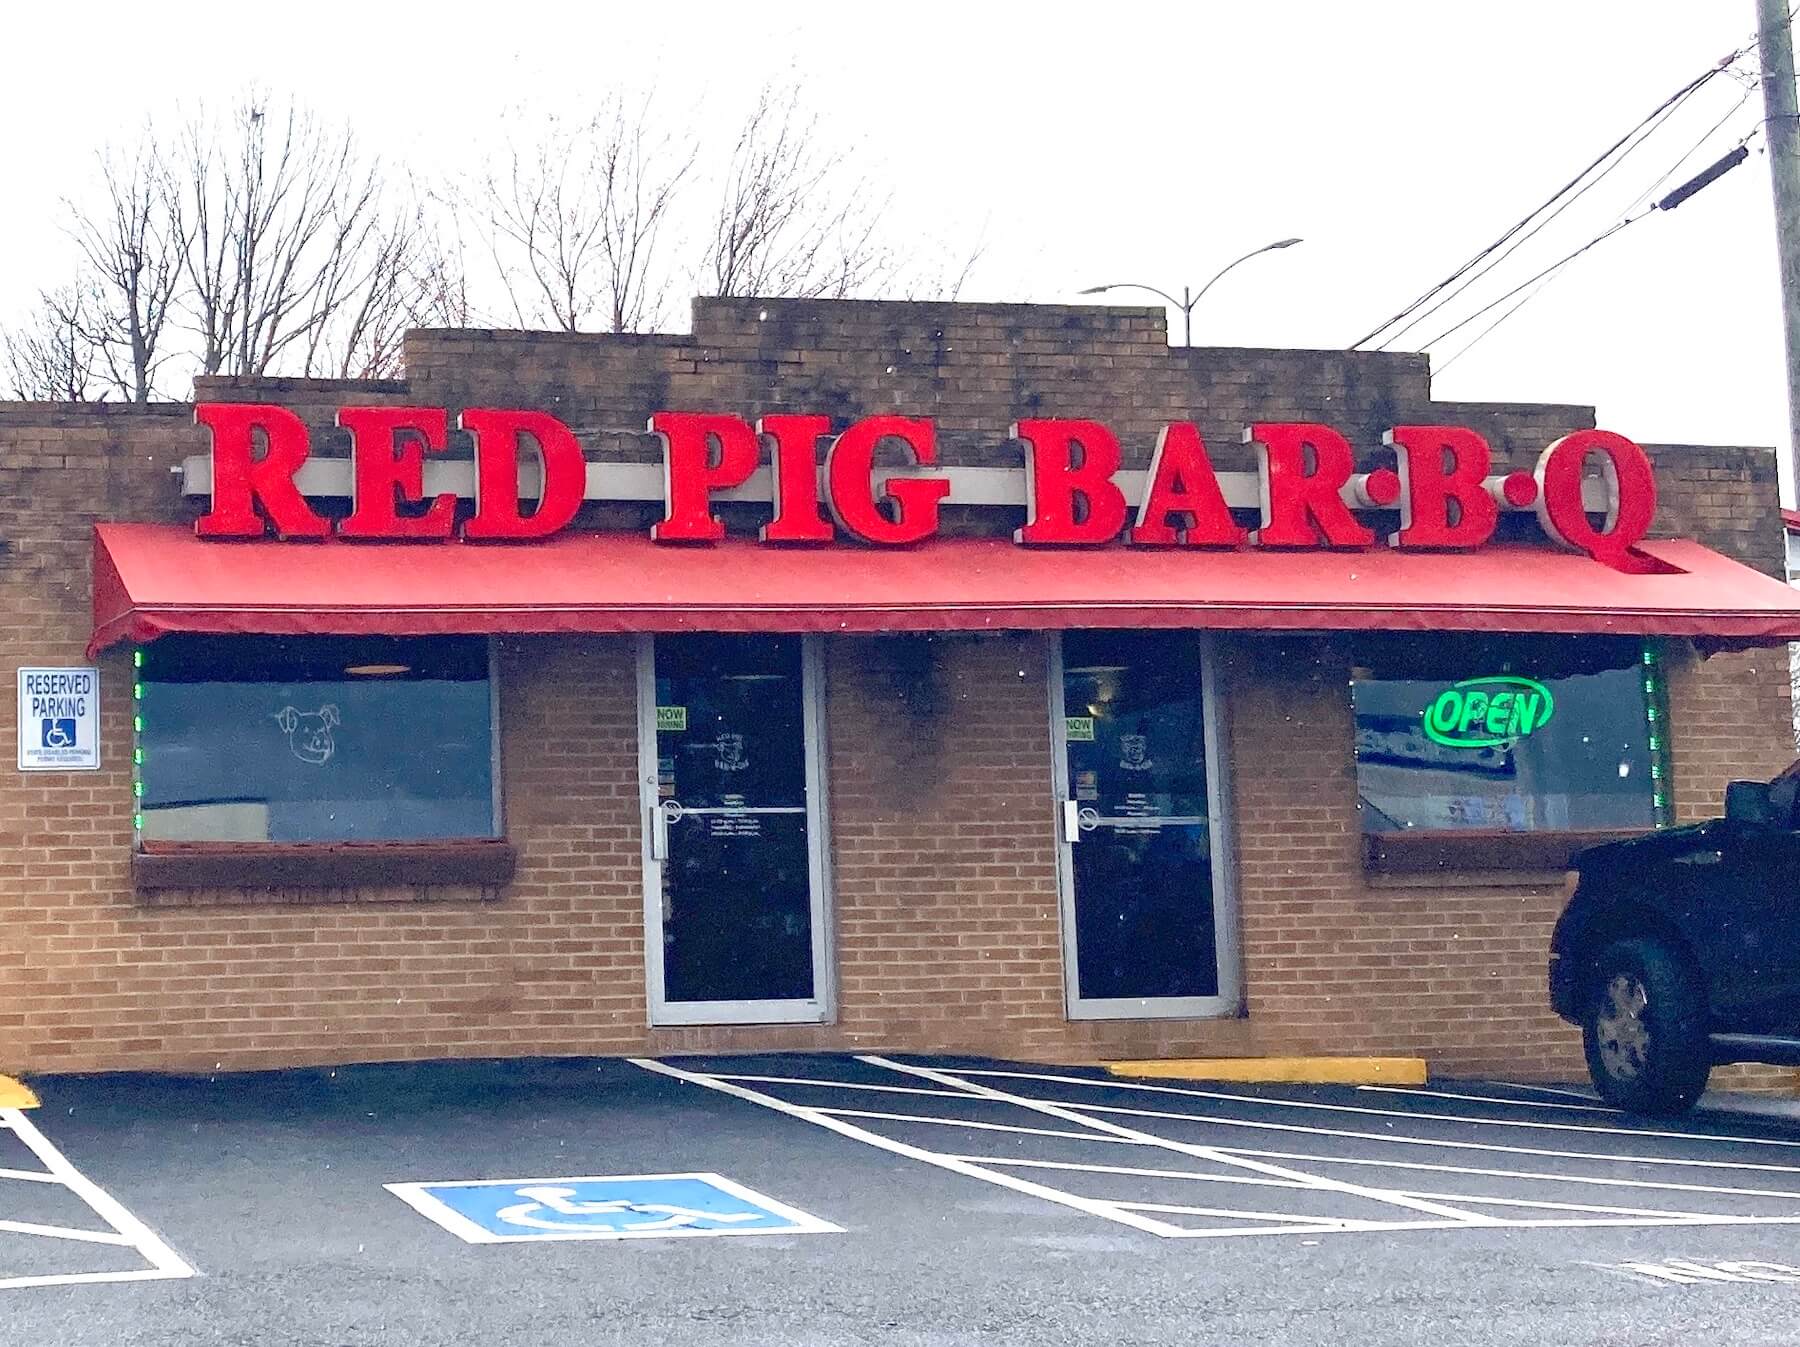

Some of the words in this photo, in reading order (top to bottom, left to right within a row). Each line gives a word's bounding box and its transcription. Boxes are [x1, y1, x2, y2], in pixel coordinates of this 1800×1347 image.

[194, 402, 585, 540] RED
[648, 411, 950, 545] PIG
[26, 674, 91, 695] RESERVED
[32, 697, 85, 717] PARKING
[657, 708, 683, 720] NOW
[1432, 690, 1540, 735] OPEN
[1067, 719, 1090, 730] NOW
